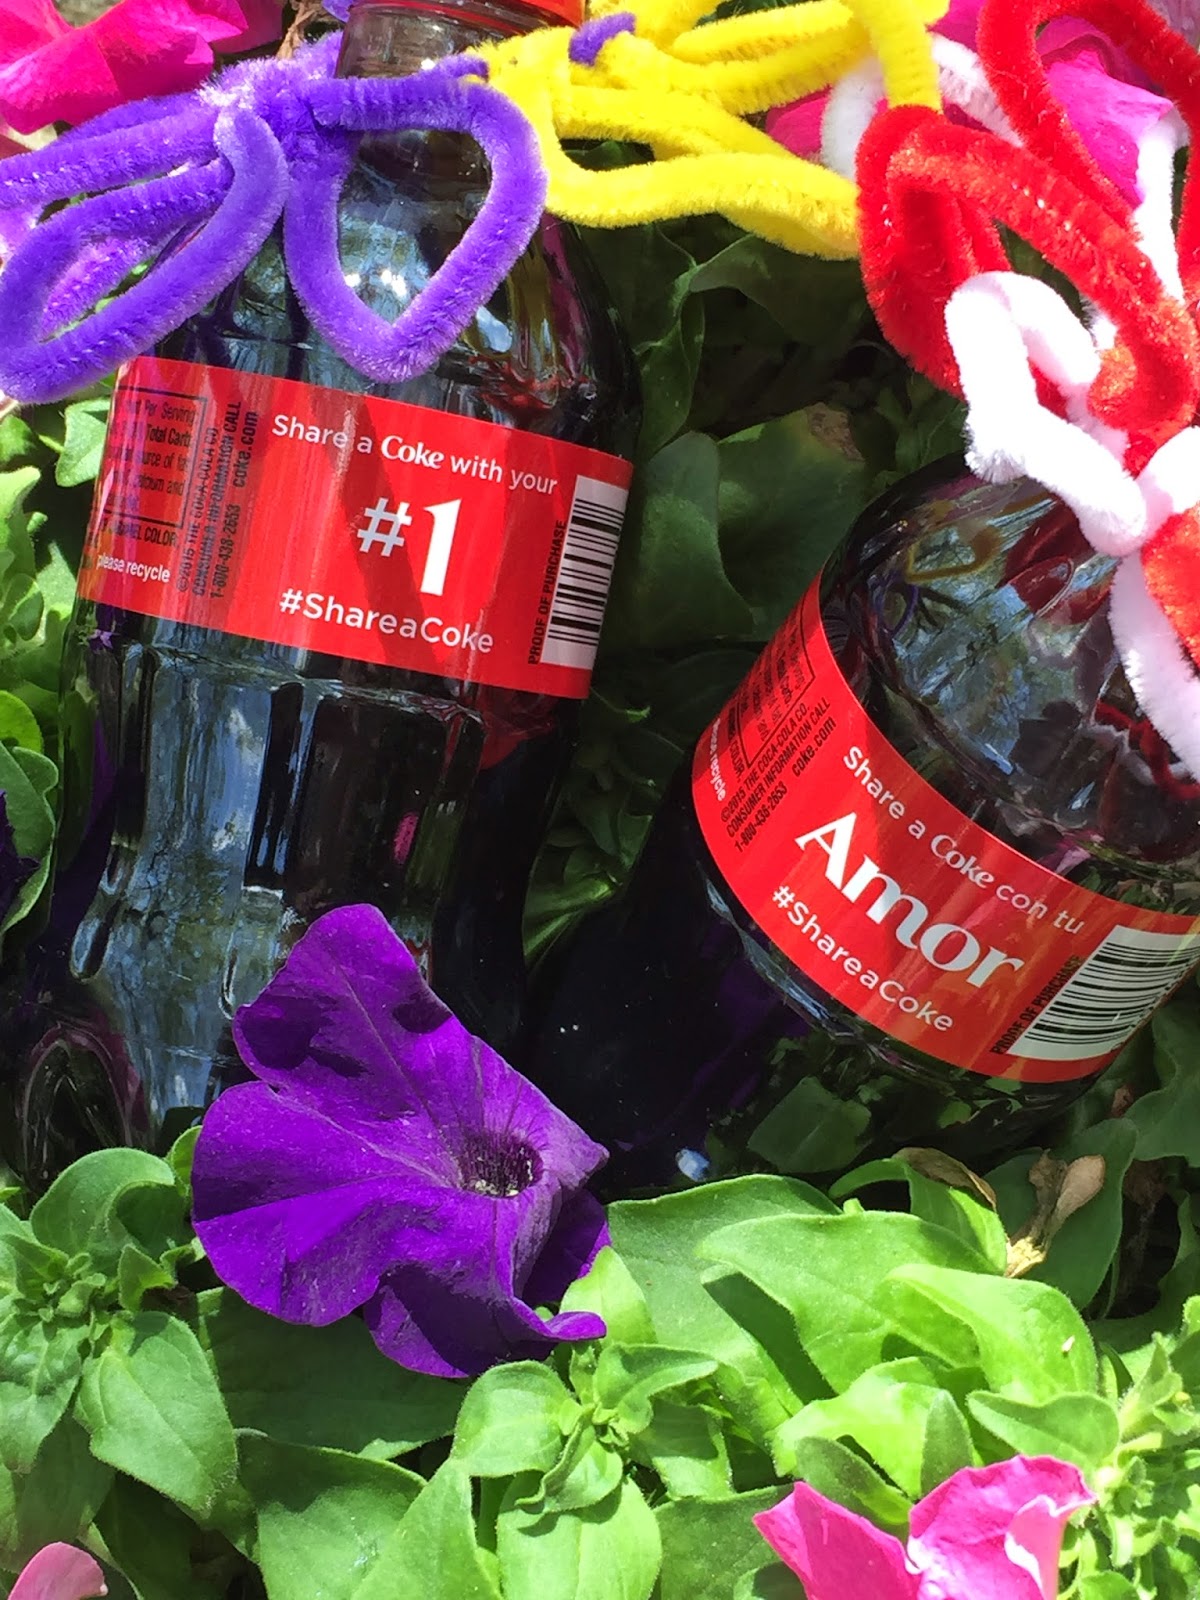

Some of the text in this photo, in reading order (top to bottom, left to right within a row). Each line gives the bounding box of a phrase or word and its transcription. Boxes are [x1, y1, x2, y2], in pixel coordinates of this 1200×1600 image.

[147, 423, 168, 443] Total
[160, 401, 196, 426] Serving
[232, 410, 259, 488] coke.com
[271, 413, 558, 496] Share a Coke with your
[163, 452, 175, 469] of
[207, 434, 234, 522] INFORMATION
[223, 401, 242, 433] CALL
[96, 552, 171, 583] please recycle
[188, 522, 201, 545] THE
[356, 496, 463, 597] #1
[278, 587, 495, 654] #ShareaCoke
[527, 519, 568, 665] PROOF OF PURCHASE
[710, 753, 726, 801] recycle
[726, 781, 768, 838] CONSUMER
[763, 721, 814, 786] INFORMATION
[808, 696, 831, 734] CALL
[742, 764, 761, 788] THE
[757, 719, 799, 775] COCA-COLA
[795, 702, 811, 725] CO.
[790, 716, 837, 778] coke.com
[842, 744, 1086, 936] Share a Coke con tu
[794, 811, 1026, 989] Amor
[772, 884, 954, 1033] #ShareaCoke
[989, 953, 1089, 1055] PROOF OF PURCHASE
